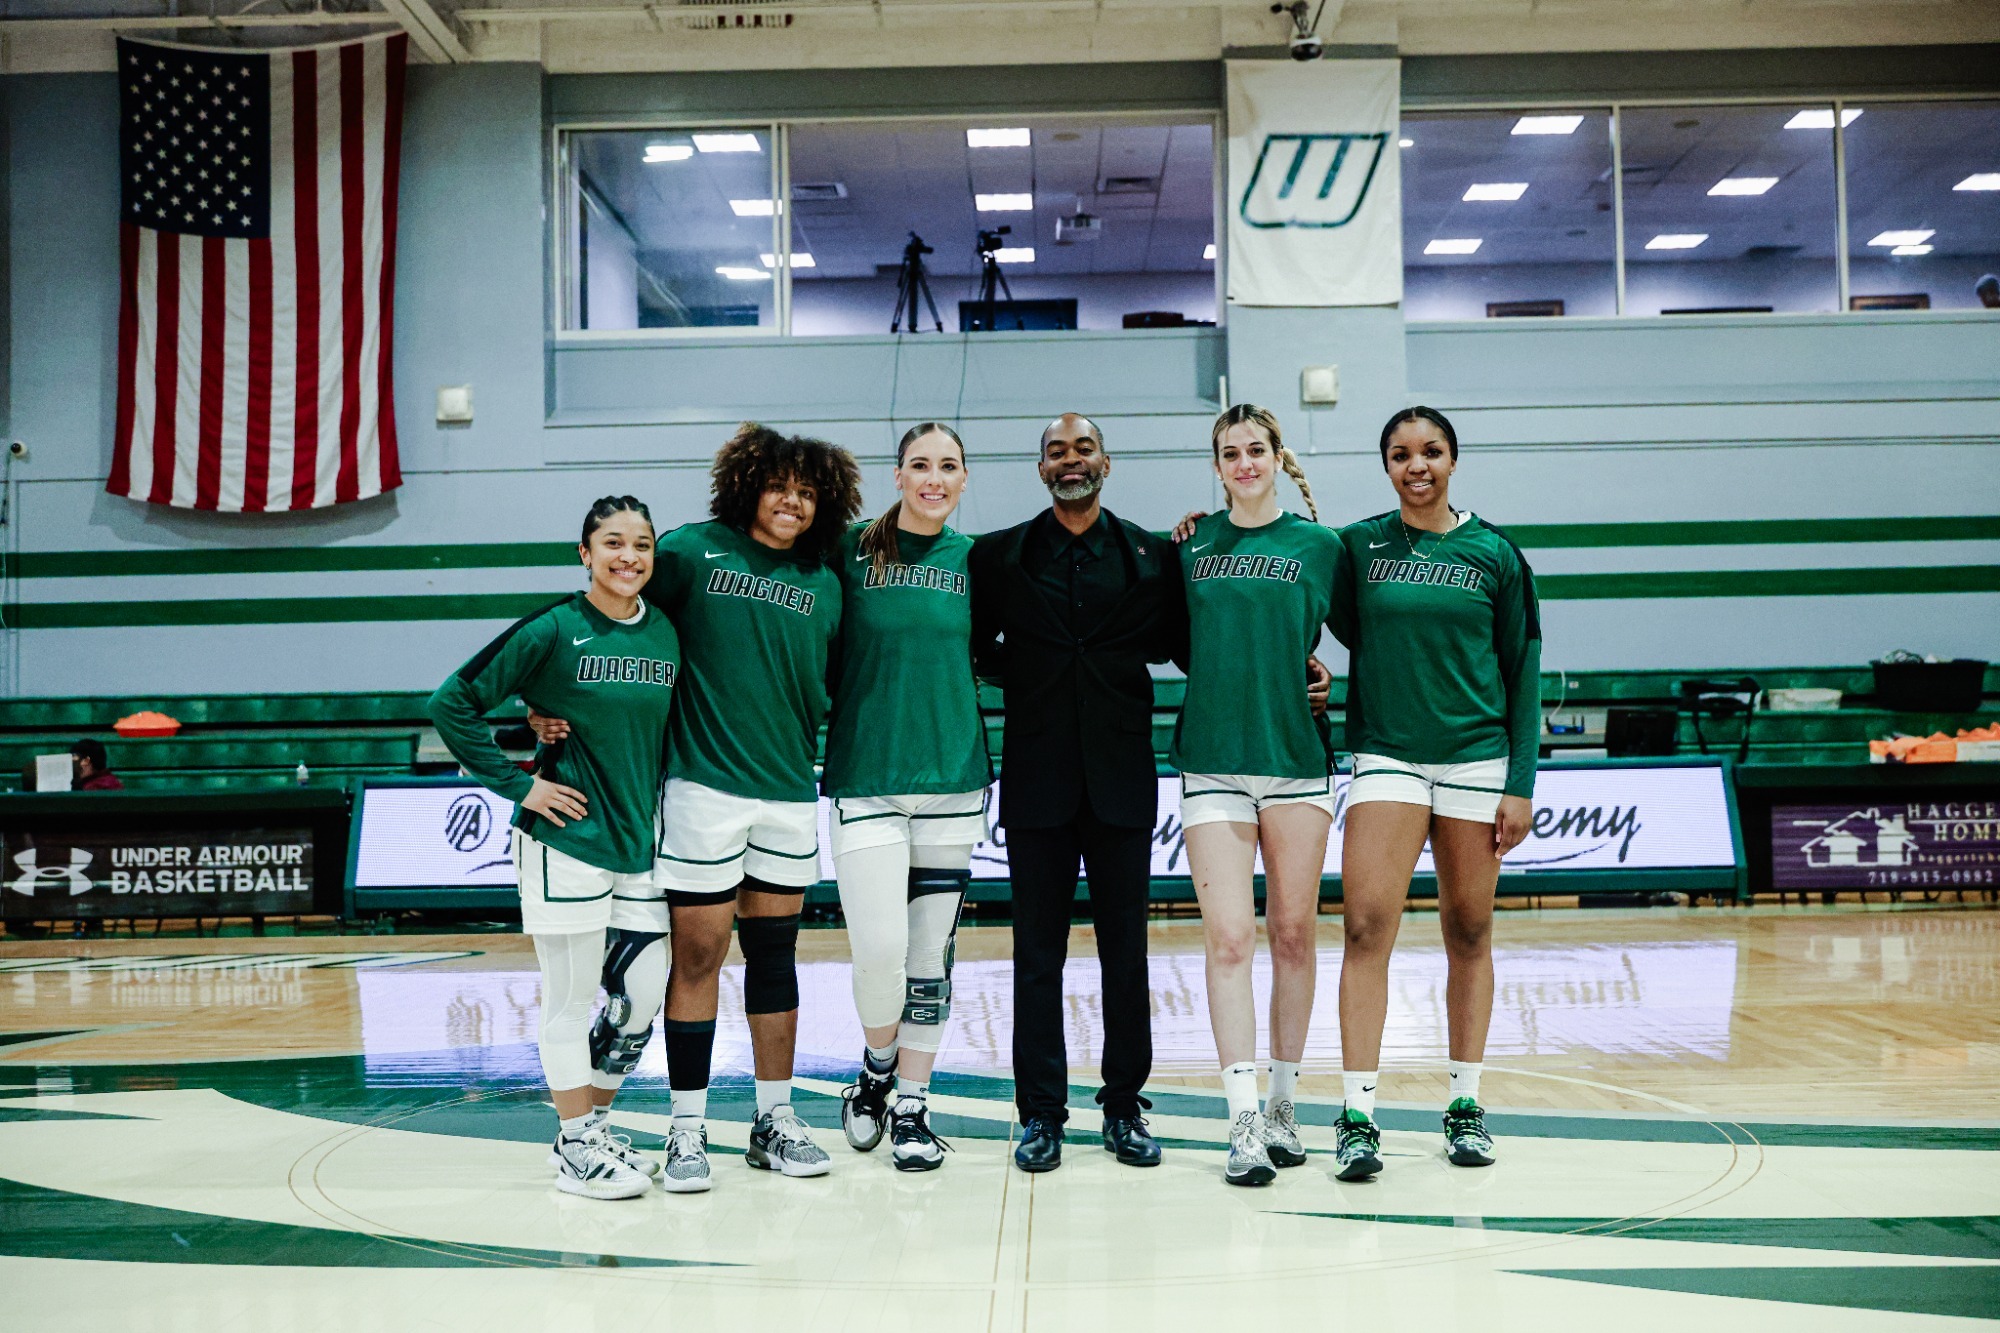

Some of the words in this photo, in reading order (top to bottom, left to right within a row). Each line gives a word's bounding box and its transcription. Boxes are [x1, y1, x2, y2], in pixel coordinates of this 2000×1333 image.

[1239, 131, 1391, 229] W
[864, 563, 966, 596] WAGNER
[1191, 555, 1302, 583] WAGNER
[1367, 558, 1483, 591] WAGNER
[707, 568, 816, 616] WAGNER
[577, 655, 676, 688] WAGNER
[111, 847, 192, 868] UNDER
[196, 844, 304, 866] ARMOUR
[111, 867, 310, 895] BASKETBALL
